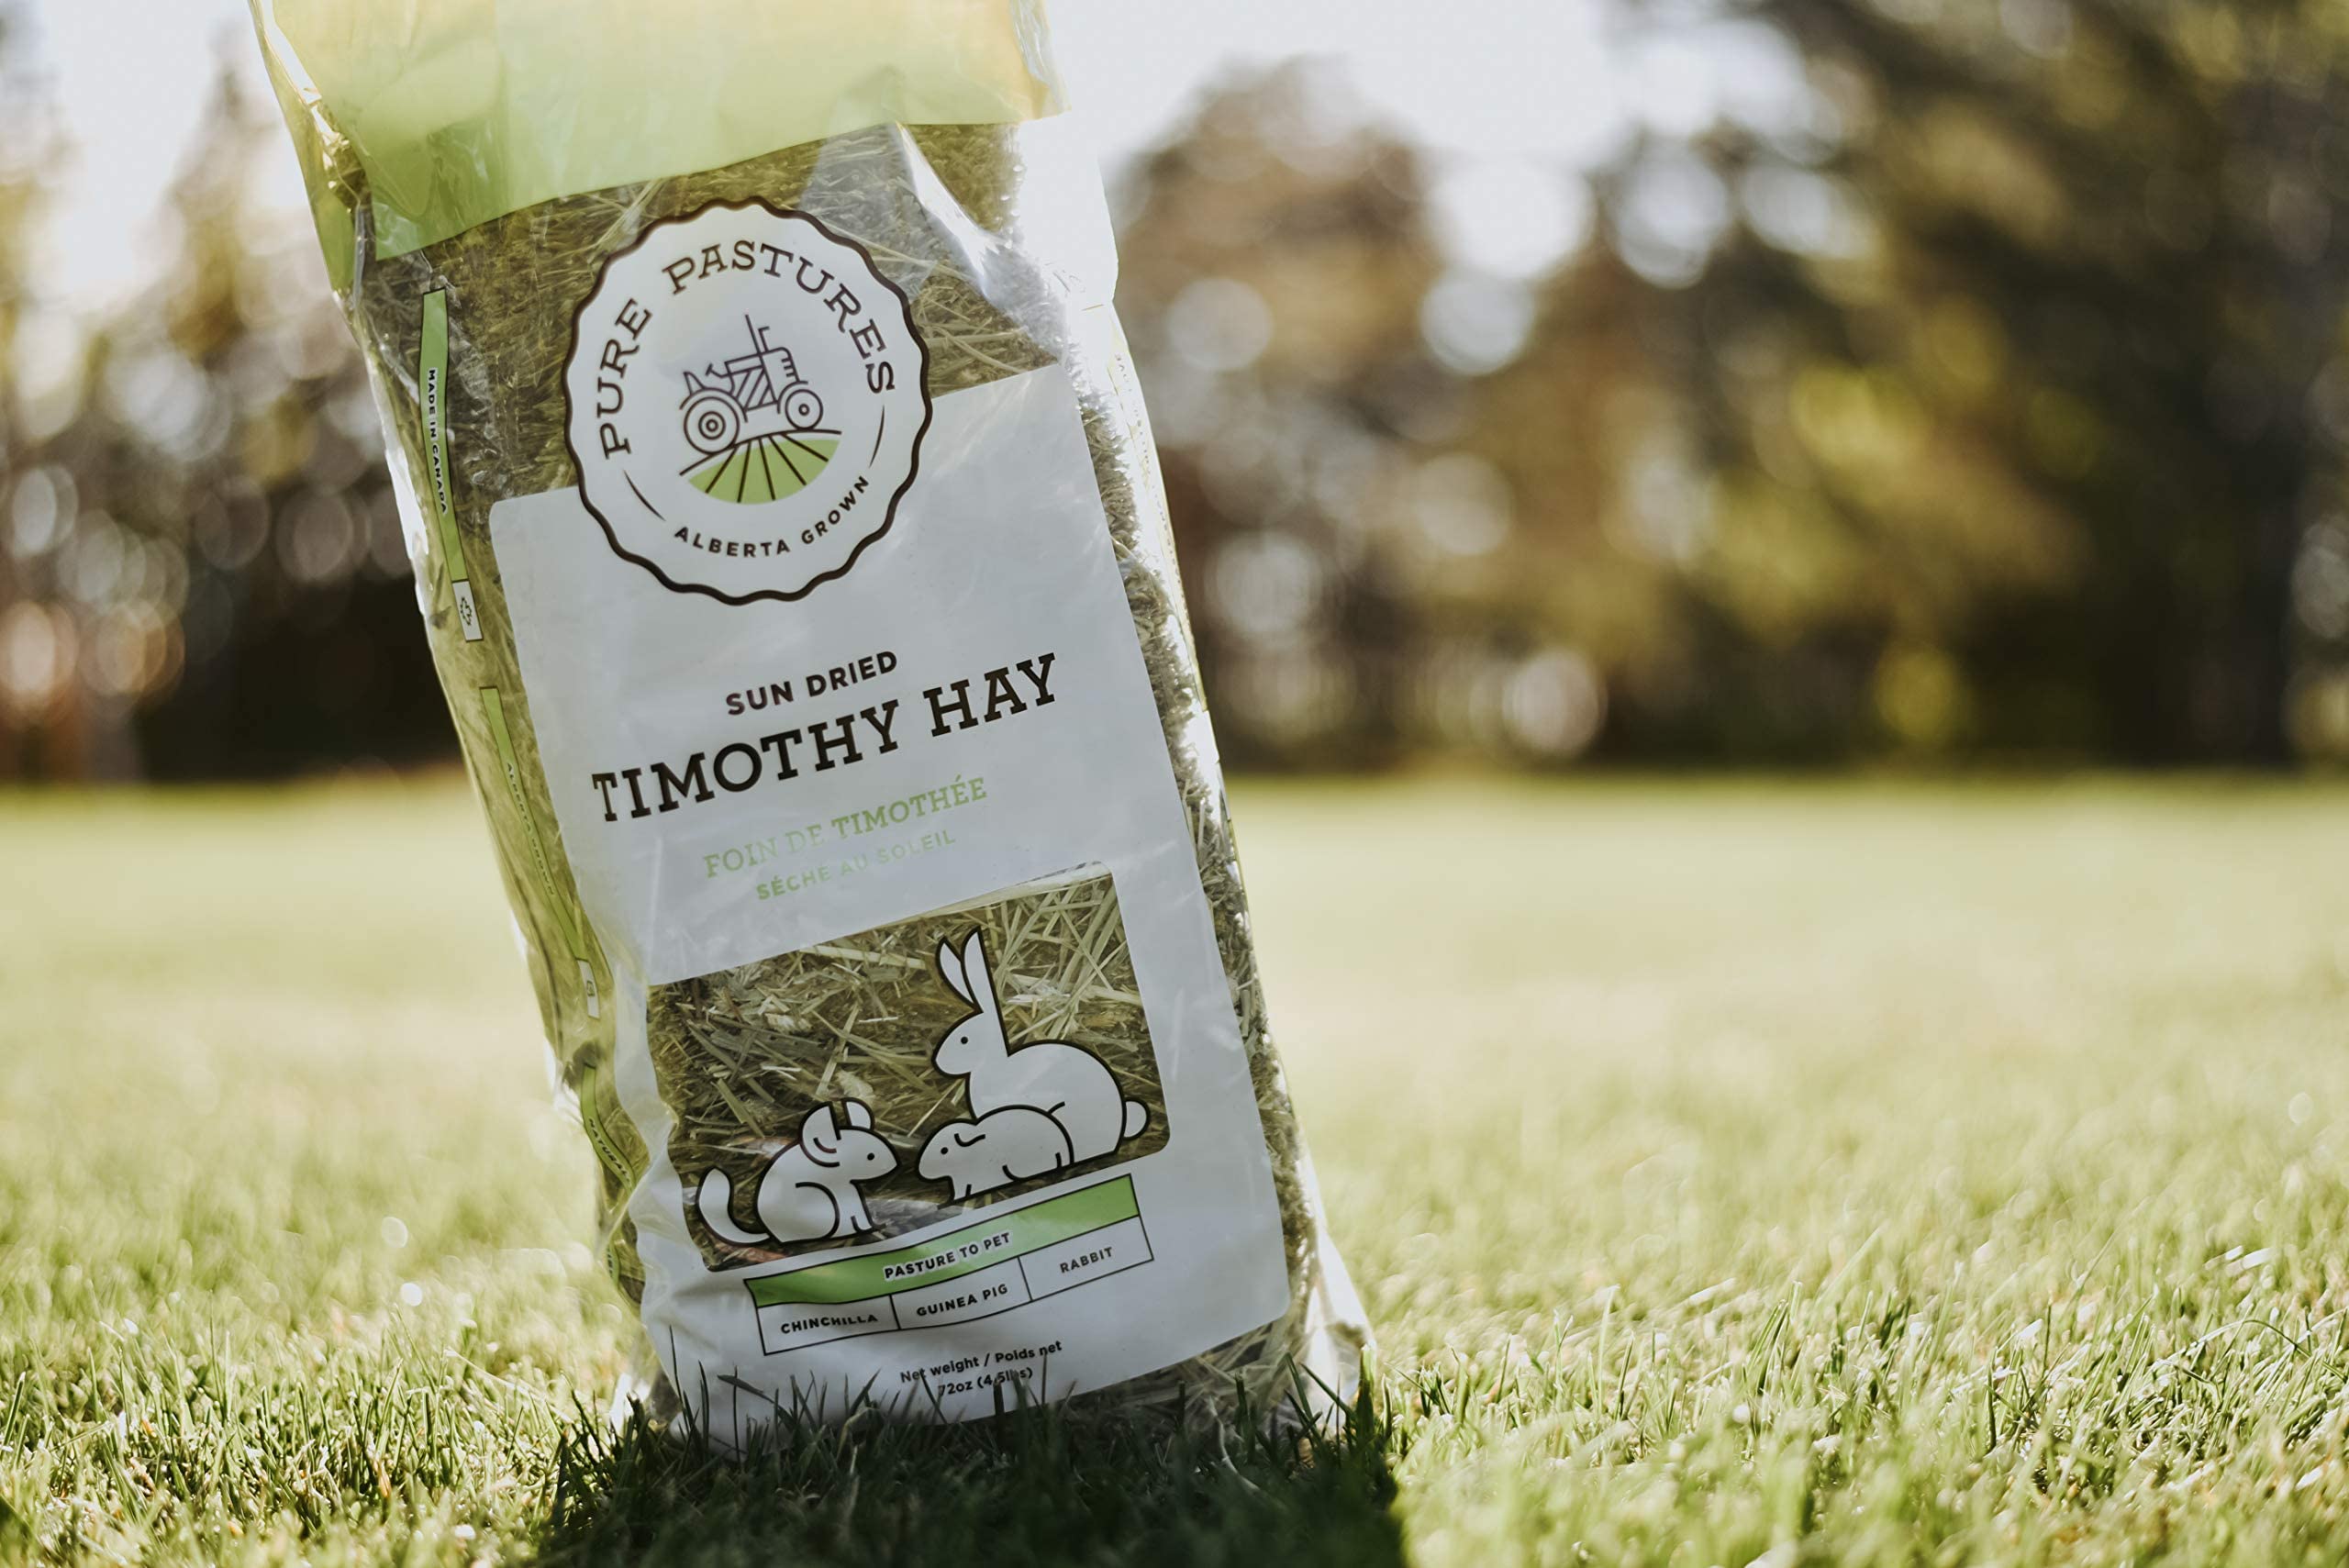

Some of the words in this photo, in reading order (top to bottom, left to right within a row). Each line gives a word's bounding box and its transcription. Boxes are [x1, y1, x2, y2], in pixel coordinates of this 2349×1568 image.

[596, 298, 652, 459] PURE
[662, 239, 896, 395] PASTURES
[430, 421, 437, 438] IN
[432, 444, 447, 514] CANADA
[674, 526, 790, 558] ALBERTA
[801, 475, 870, 545] GROWN
[725, 681, 794, 716] SUN
[806, 651, 897, 697] DRIED
[592, 699, 899, 822] TIMOTHY
[923, 652, 1056, 737] HAY
[703, 837, 780, 878] FOIN
[785, 824, 825, 853] DE
[830, 774, 988, 840] TIMOTHÉE
[756, 865, 831, 900] SÉCHE
[840, 853, 870, 877] AU
[876, 829, 956, 864] SOLEIL
[885, 1251, 956, 1279] PASTURE
[960, 1244, 980, 1258] TO
[985, 1232, 1011, 1251] PET
[1060, 1246, 1113, 1273] RABBIT
[780, 1313, 879, 1334] CHINCHILLA
[916, 1293, 978, 1317] GUINEA
[984, 1283, 1009, 1300] PIG
[899, 1367, 926, 1384] Net
[930, 1356, 980, 1377] weight
[984, 1352, 991, 1367] /
[995, 1348, 1035, 1363] Poids
[1039, 1340, 1063, 1356] net
